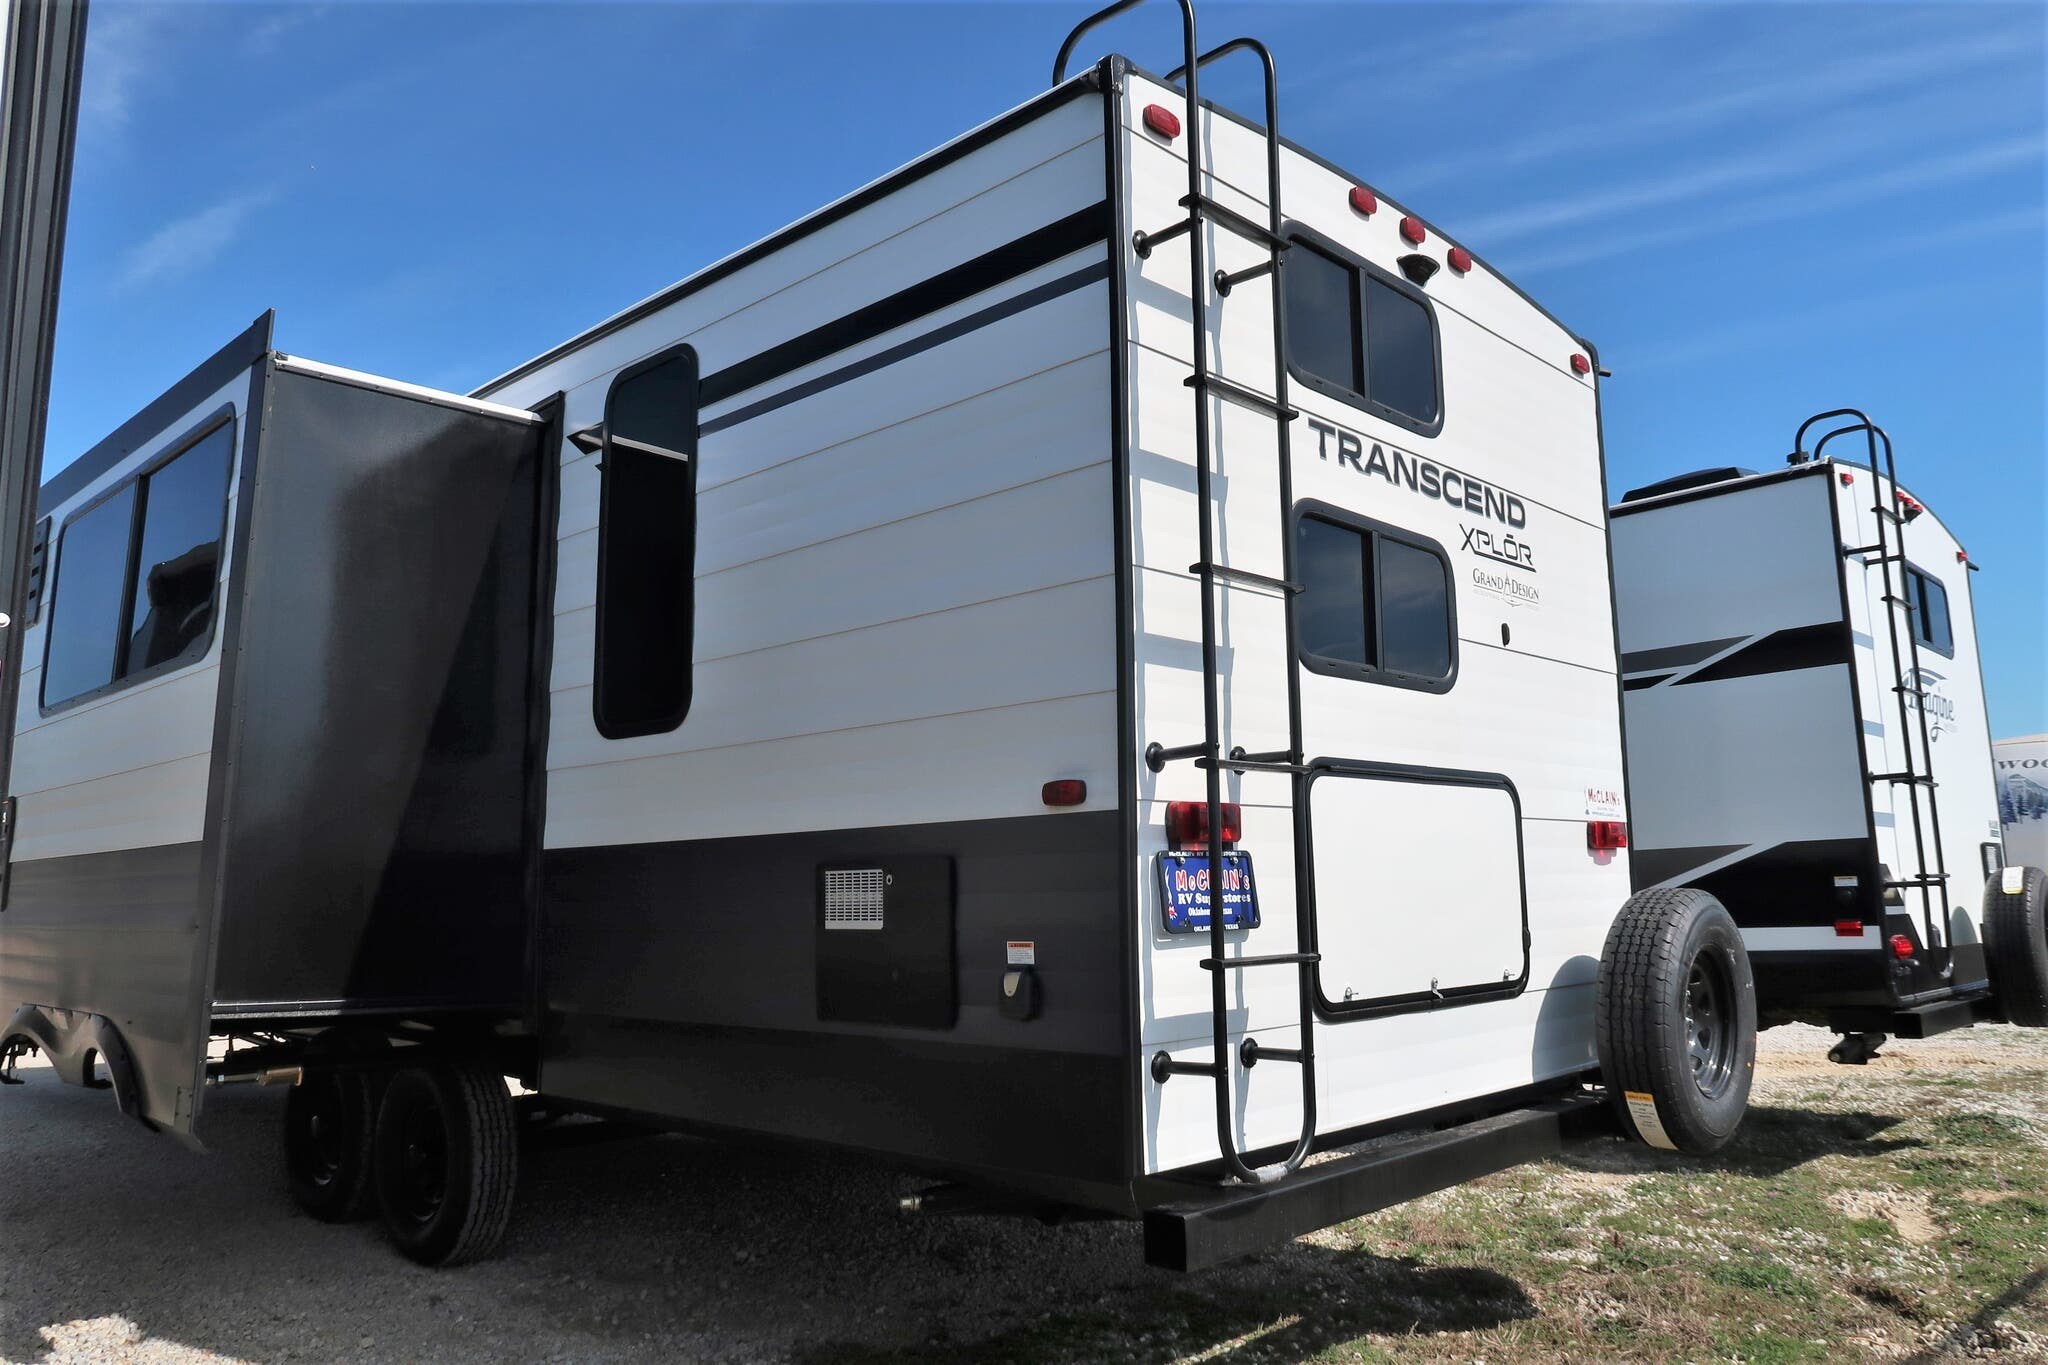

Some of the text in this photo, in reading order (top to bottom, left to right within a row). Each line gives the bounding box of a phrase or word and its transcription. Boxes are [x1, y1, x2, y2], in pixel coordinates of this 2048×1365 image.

[1307, 417, 1526, 530] TRANSCEND
[1472, 567, 1504, 590] GRAND
[1511, 579, 1539, 600] DESIGN
[1176, 869, 1249, 891] McCIN's
[1178, 893, 1251, 906] RV Sustores
